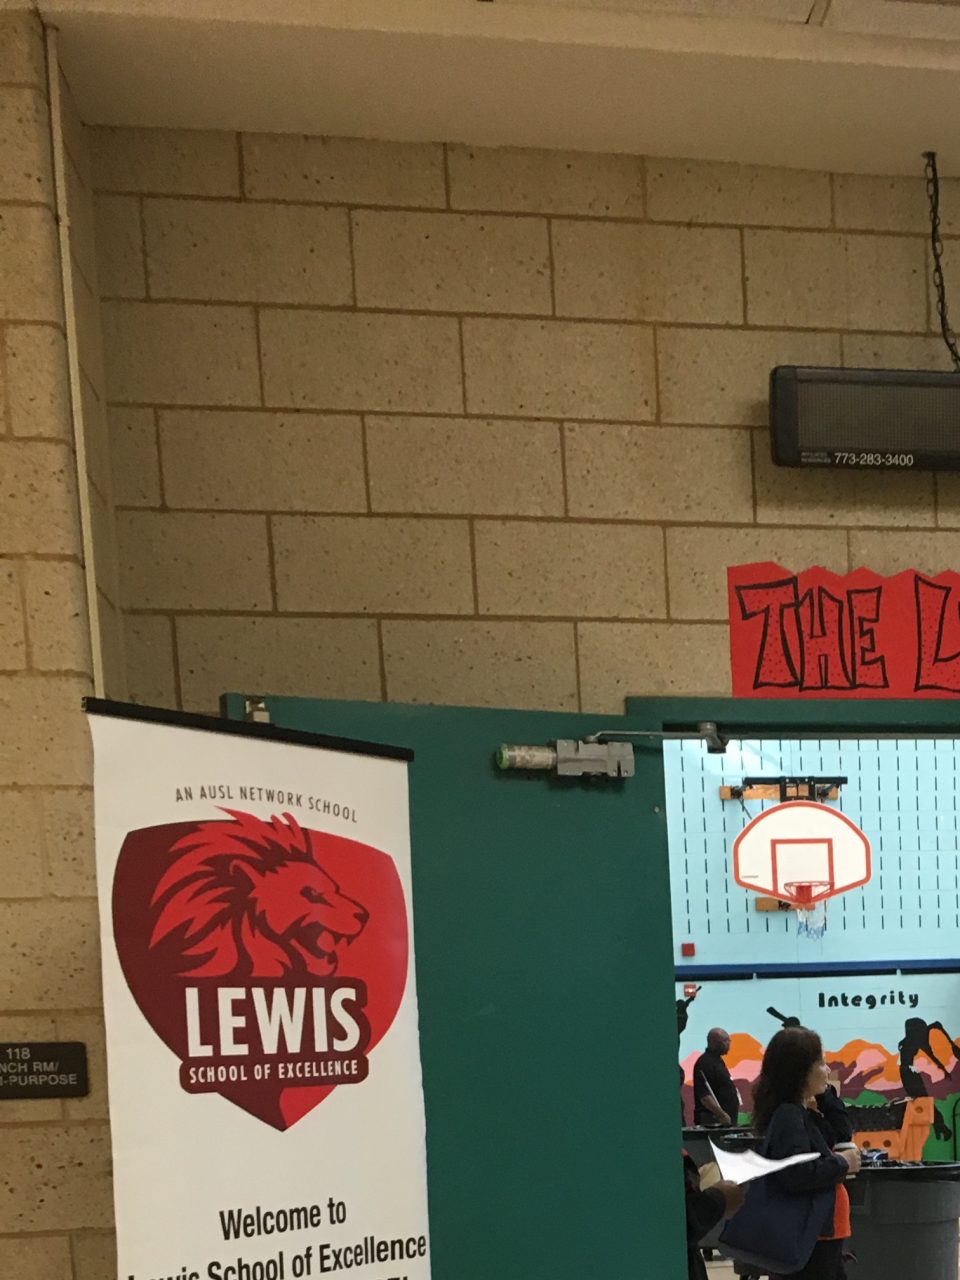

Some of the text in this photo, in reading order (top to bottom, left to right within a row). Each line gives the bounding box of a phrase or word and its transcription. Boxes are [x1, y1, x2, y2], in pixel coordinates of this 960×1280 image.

[834, 452, 914, 466] 773-283-3400
[735, 576, 889, 691] THE
[175, 785, 358, 823] AN AUSL NETWORK SCHOOL
[818, 990, 920, 1009] Integrity
[184, 986, 361, 1057] LEWIS
[6, 1047, 31, 1060] 118
[189, 1059, 359, 1084] SCHOOL OF EXCELLENCE
[219, 1197, 347, 1241] Welcome to
[291, 1246, 313, 1279] of
[319, 1232, 427, 1273] Excellence
